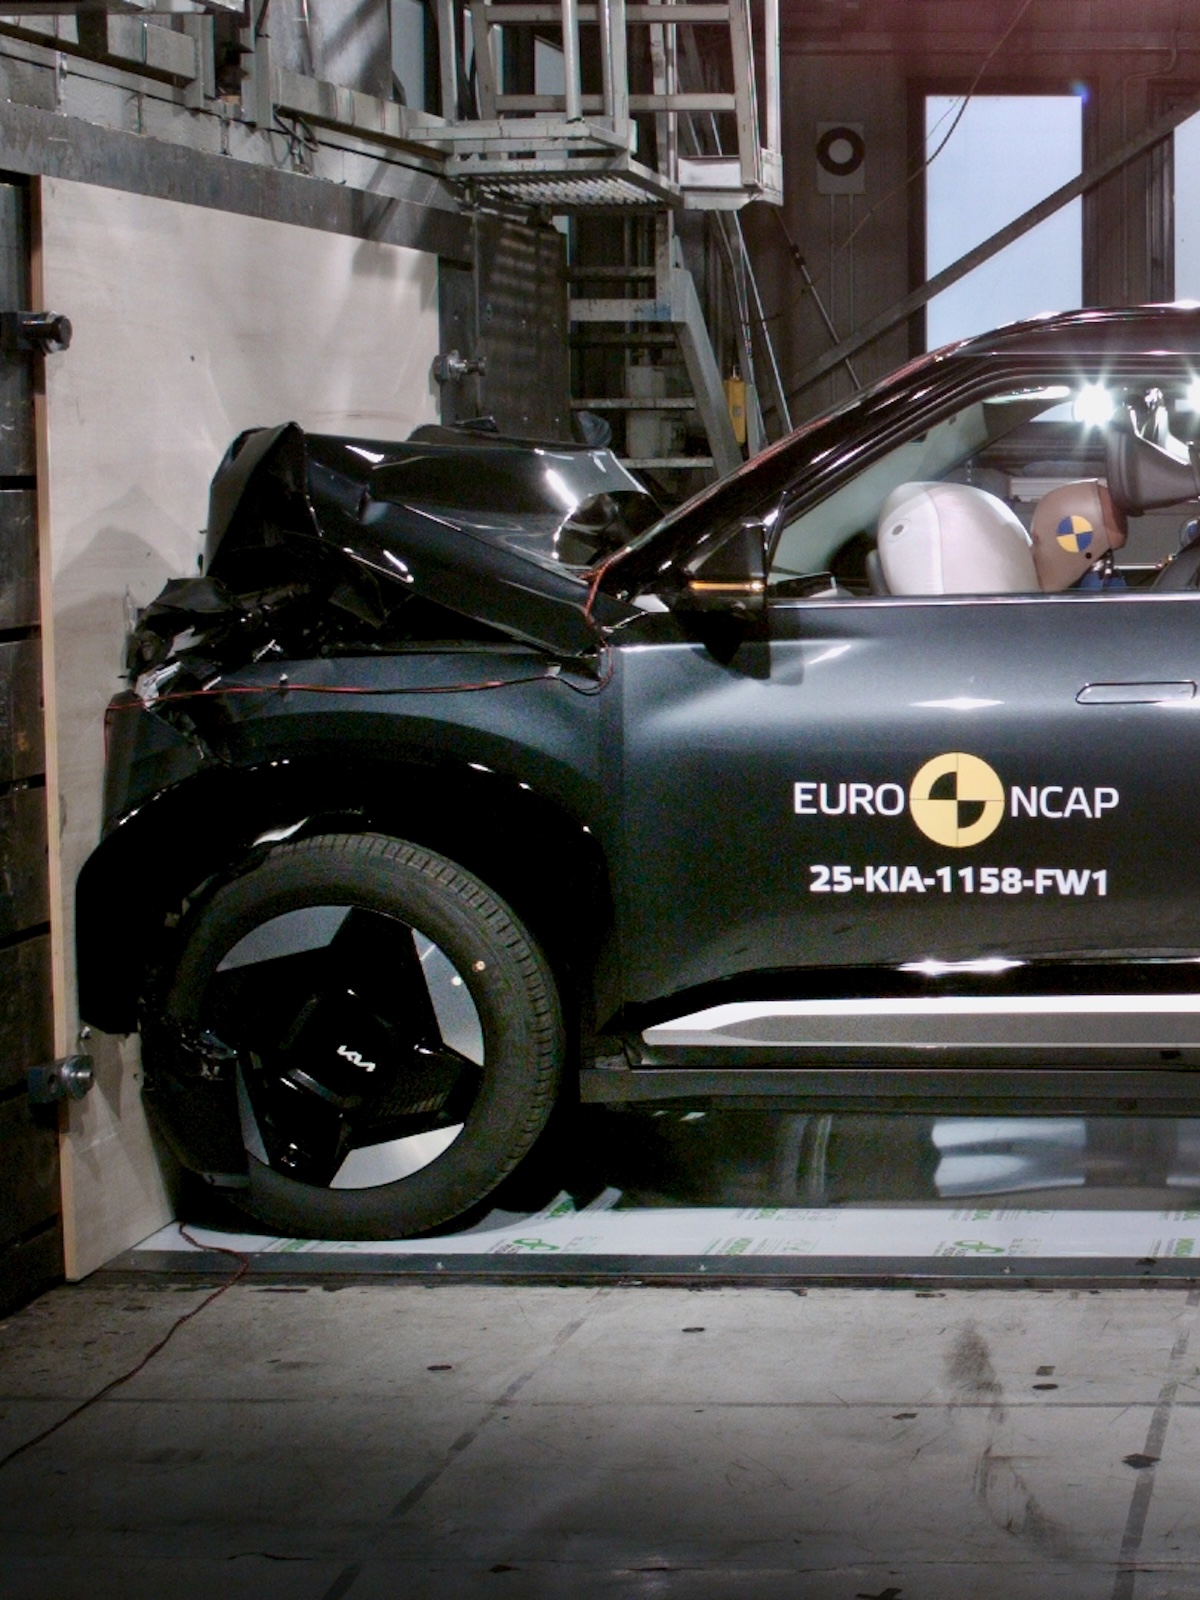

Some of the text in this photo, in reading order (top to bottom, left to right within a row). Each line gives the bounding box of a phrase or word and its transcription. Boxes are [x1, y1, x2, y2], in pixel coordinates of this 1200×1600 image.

[793, 782, 1119, 818] EURO NCAP
[809, 865, 1108, 896] 25-KIA-1158-FW1
